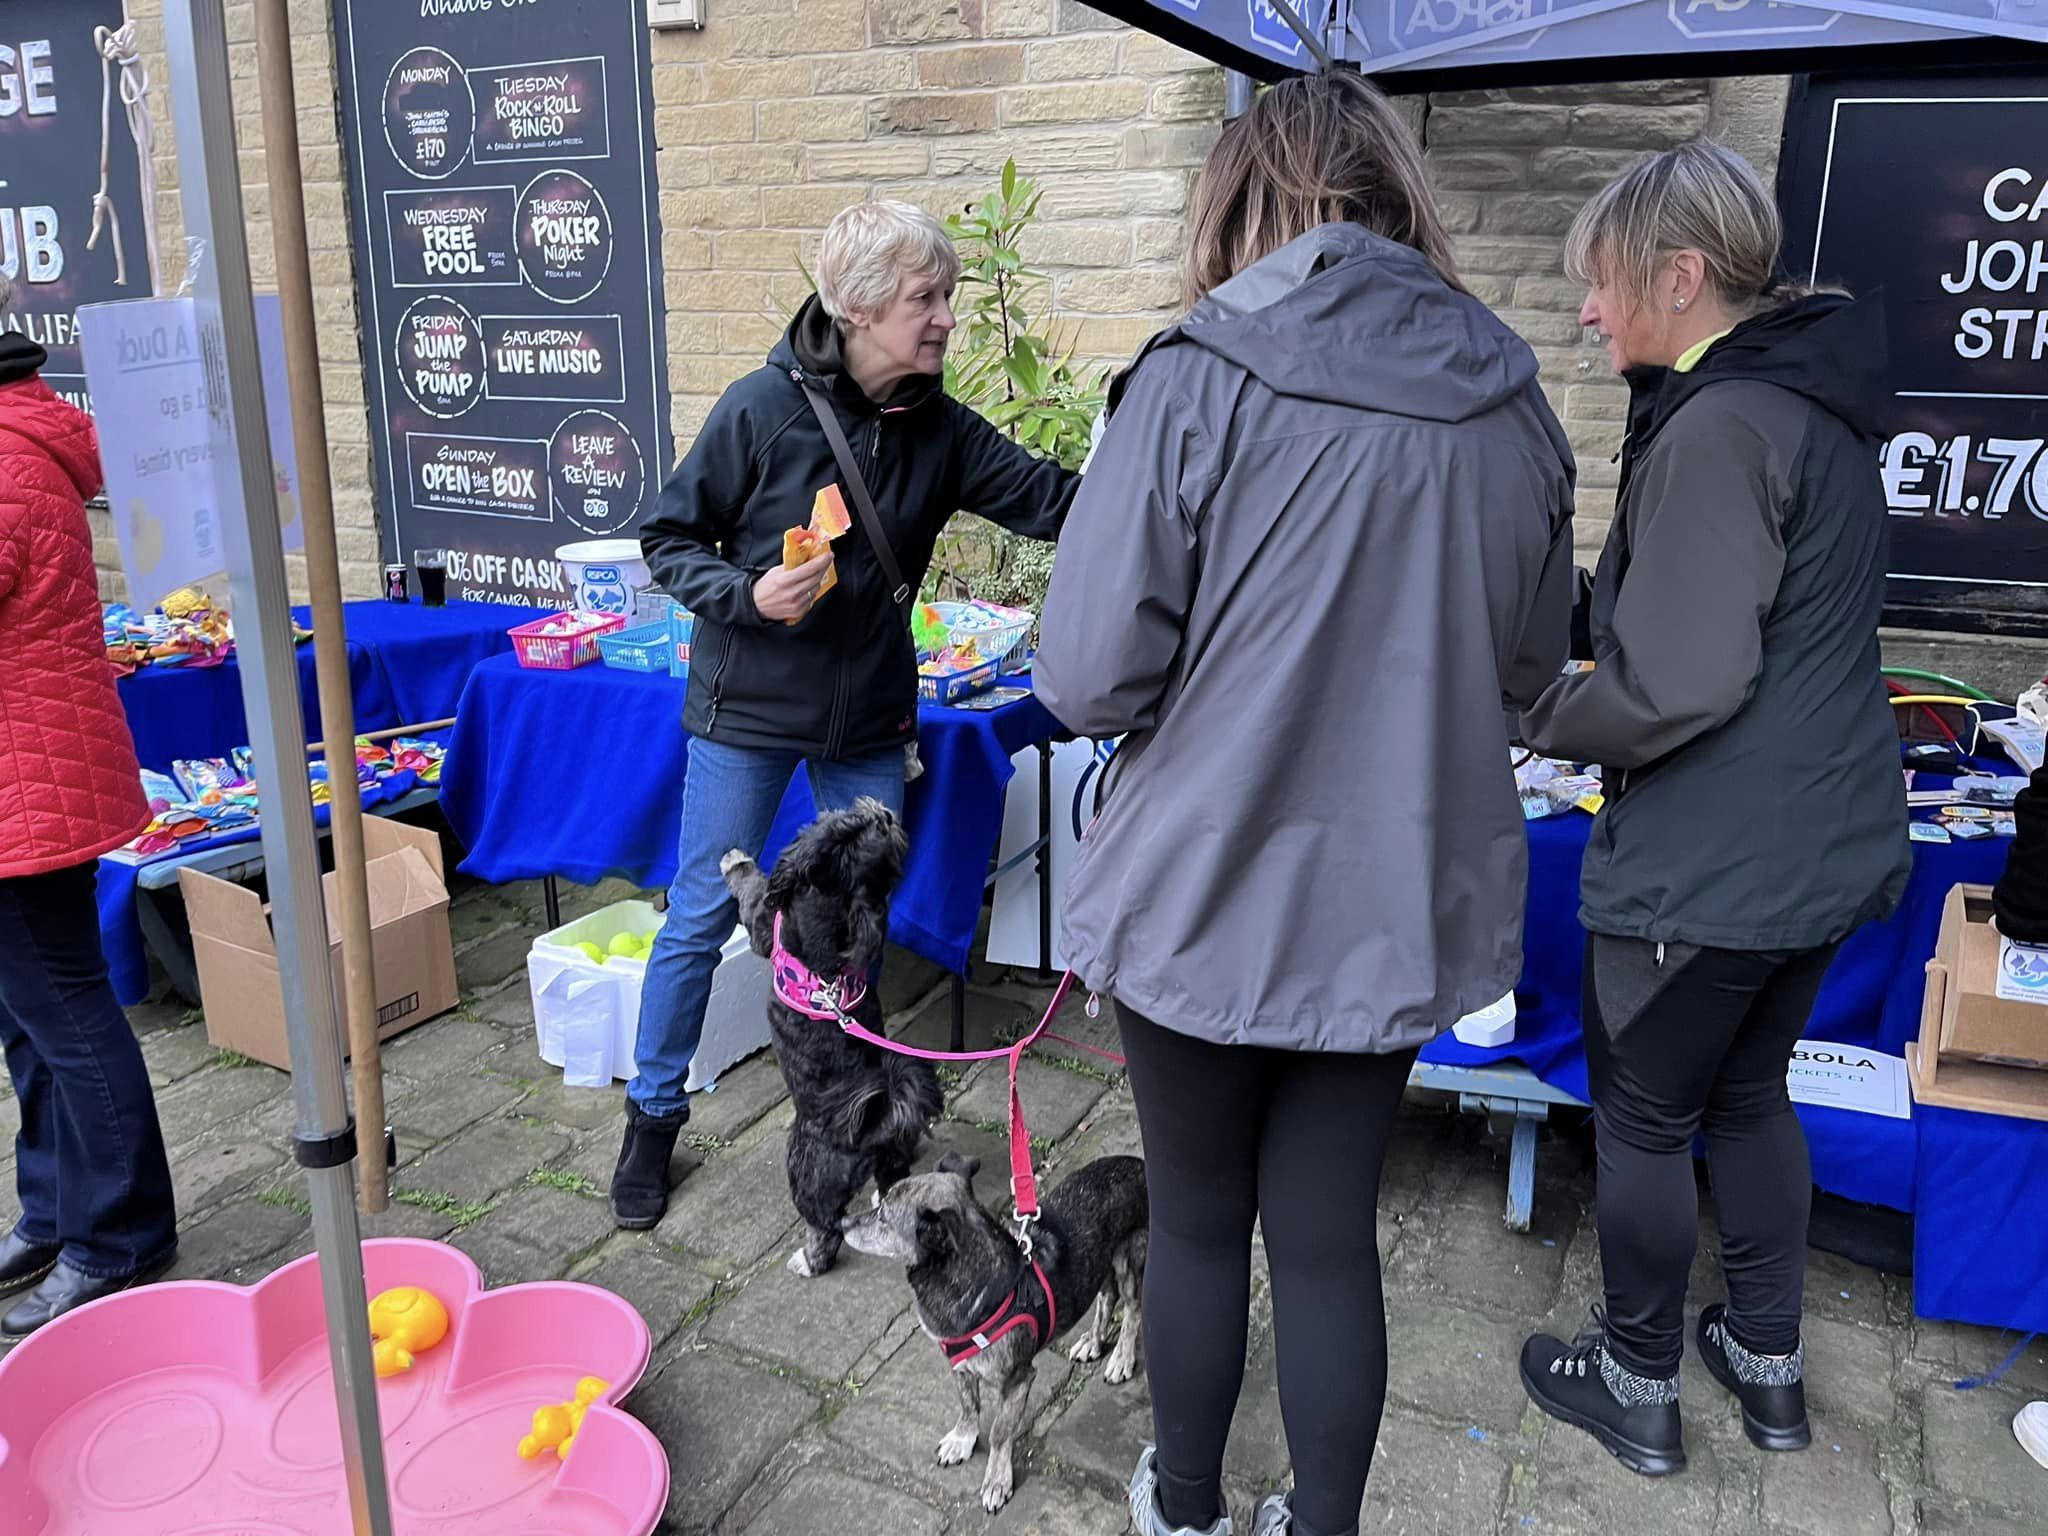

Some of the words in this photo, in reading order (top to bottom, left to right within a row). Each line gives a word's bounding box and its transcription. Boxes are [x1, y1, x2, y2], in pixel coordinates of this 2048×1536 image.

[400, 66, 451, 84] MONDAY
[494, 74, 569, 95] TUESDAY
[494, 96, 535, 120] ROCK
[543, 95, 582, 116] ROLL
[509, 115, 564, 139] BINGO
[404, 207, 488, 225] WEDNESDAY
[530, 200, 590, 215] THURSDAY
[422, 224, 477, 251] FREE
[531, 215, 600, 246] POKER
[423, 250, 485, 275] POOL
[543, 244, 585, 269] Night
[412, 315, 465, 331] FRIDAY
[414, 331, 467, 359] JUMP
[502, 330, 583, 347] SATURDAY
[430, 359, 451, 371] the
[497, 348, 535, 374] LIVE
[539, 348, 602, 374] MUSIC
[415, 370, 473, 397] PUMP
[437, 445, 497, 465] SUNDAY
[572, 434, 615, 455] LEAVE
[582, 455, 595, 469] A
[422, 463, 471, 495] OPEN
[472, 471, 490, 489] the
[492, 466, 537, 499] BOX
[562, 464, 626, 489] REVIEW
[473, 554, 507, 585] OFF
[512, 557, 565, 593] CASK
[462, 586, 486, 602] FOR
